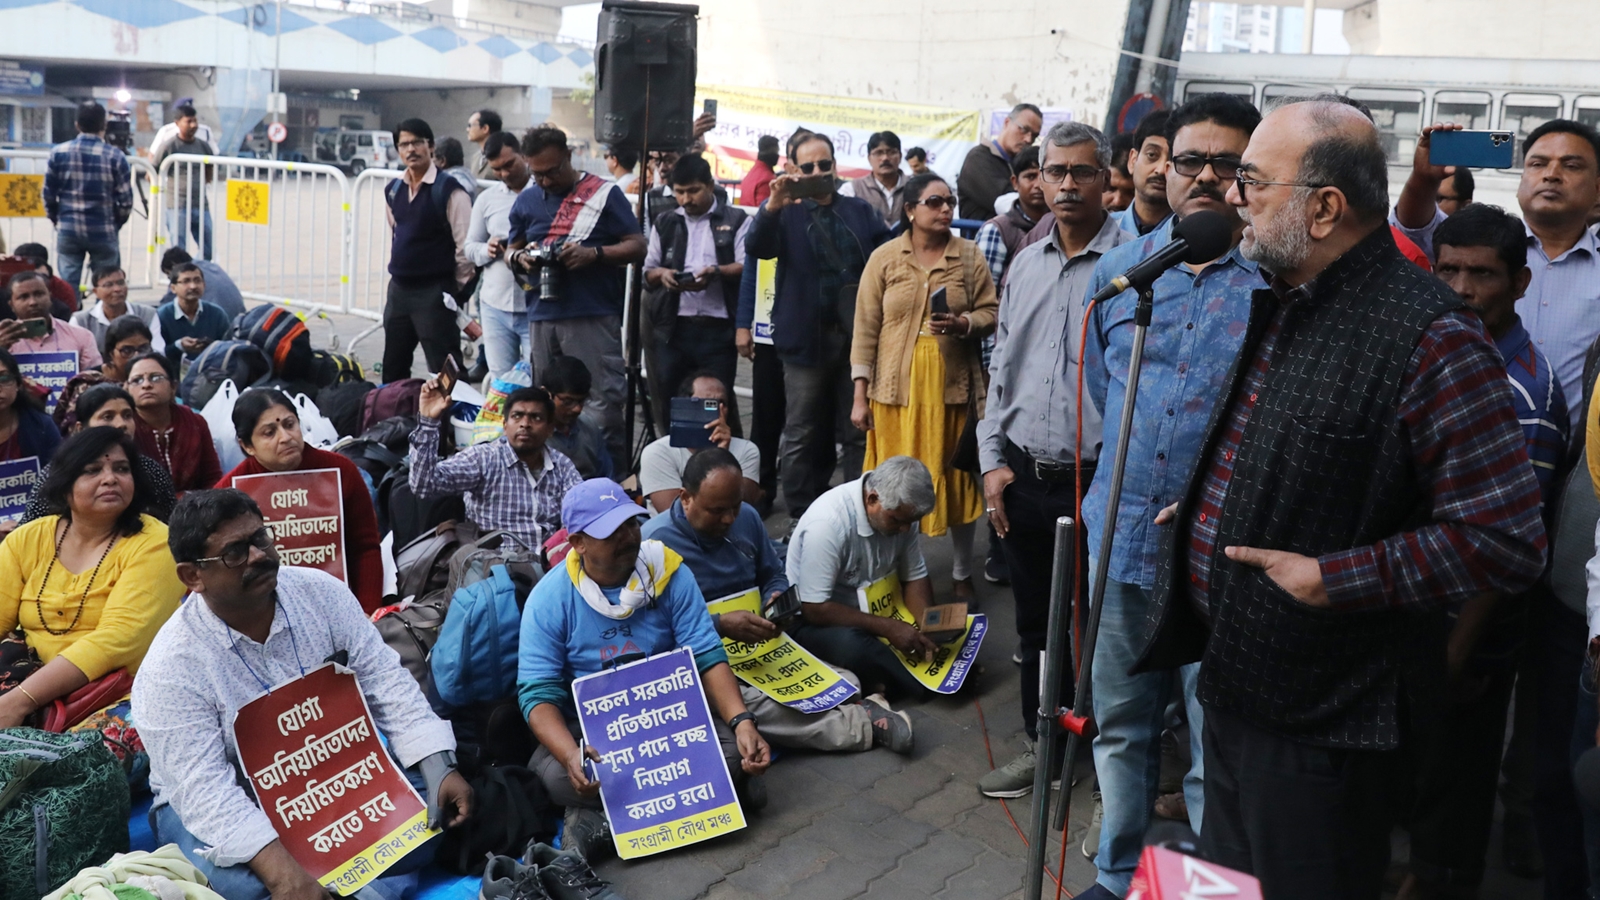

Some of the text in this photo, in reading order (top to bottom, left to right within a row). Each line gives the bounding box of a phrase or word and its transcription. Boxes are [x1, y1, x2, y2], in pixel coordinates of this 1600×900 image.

[37, 359, 75, 373] সরকারি
[270, 488, 308, 509] যোগ্য
[730, 641, 796, 672] সকল বকেয়া
[752, 658, 809, 684] D.A. প্রদান
[945, 660, 968, 687] সংগ্রামী
[583, 666, 695, 716] সকল সরকারি
[772, 672, 825, 696] করতে হবে
[277, 696, 323, 736] যোগ্য
[606, 701, 688, 742] প্রতিষ্ঠানের
[253, 715, 371, 790] অনিয়মিতদের
[600, 724, 708, 773] শূন্য পদে স্বচ্ছ
[276, 751, 385, 828] নিয়মিতকরণ
[633, 758, 691, 790] নিয়োগ
[625, 782, 715, 819] করতে হবে।
[307, 791, 396, 853] করতে হবে
[628, 812, 732, 850] সংগ্রামী যৌথ মঞ্চ
[374, 837, 405, 865] যৌথ
[402, 819, 429, 841] মঞ্চ
